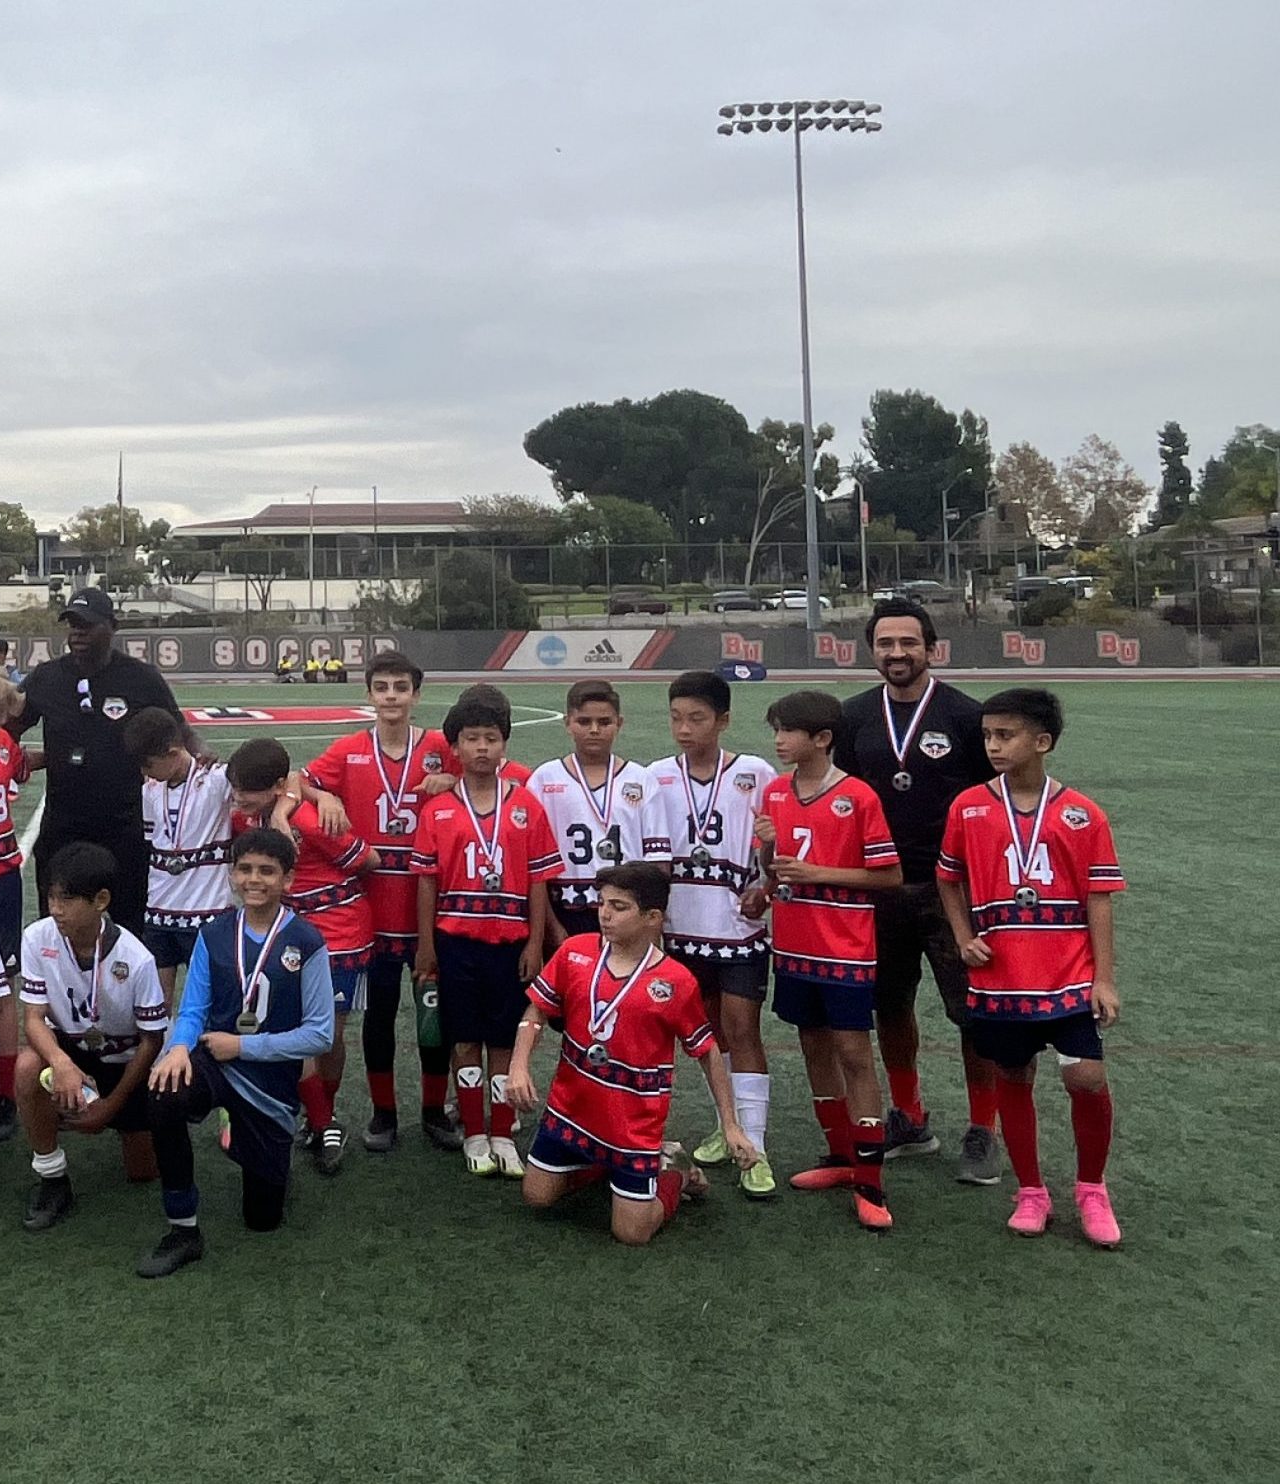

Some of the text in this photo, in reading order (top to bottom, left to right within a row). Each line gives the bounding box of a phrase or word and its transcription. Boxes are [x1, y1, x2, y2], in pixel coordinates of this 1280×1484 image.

[584, 653, 622, 663] adidas
[815, 632, 857, 666] BU
[1002, 631, 1045, 665] BU
[1096, 631, 1140, 665] BU
[375, 792, 417, 835] 15
[566, 823, 624, 866] 34
[792, 827, 813, 861] 7
[1004, 842, 1054, 886] 14
[422, 991, 439, 1008] G
